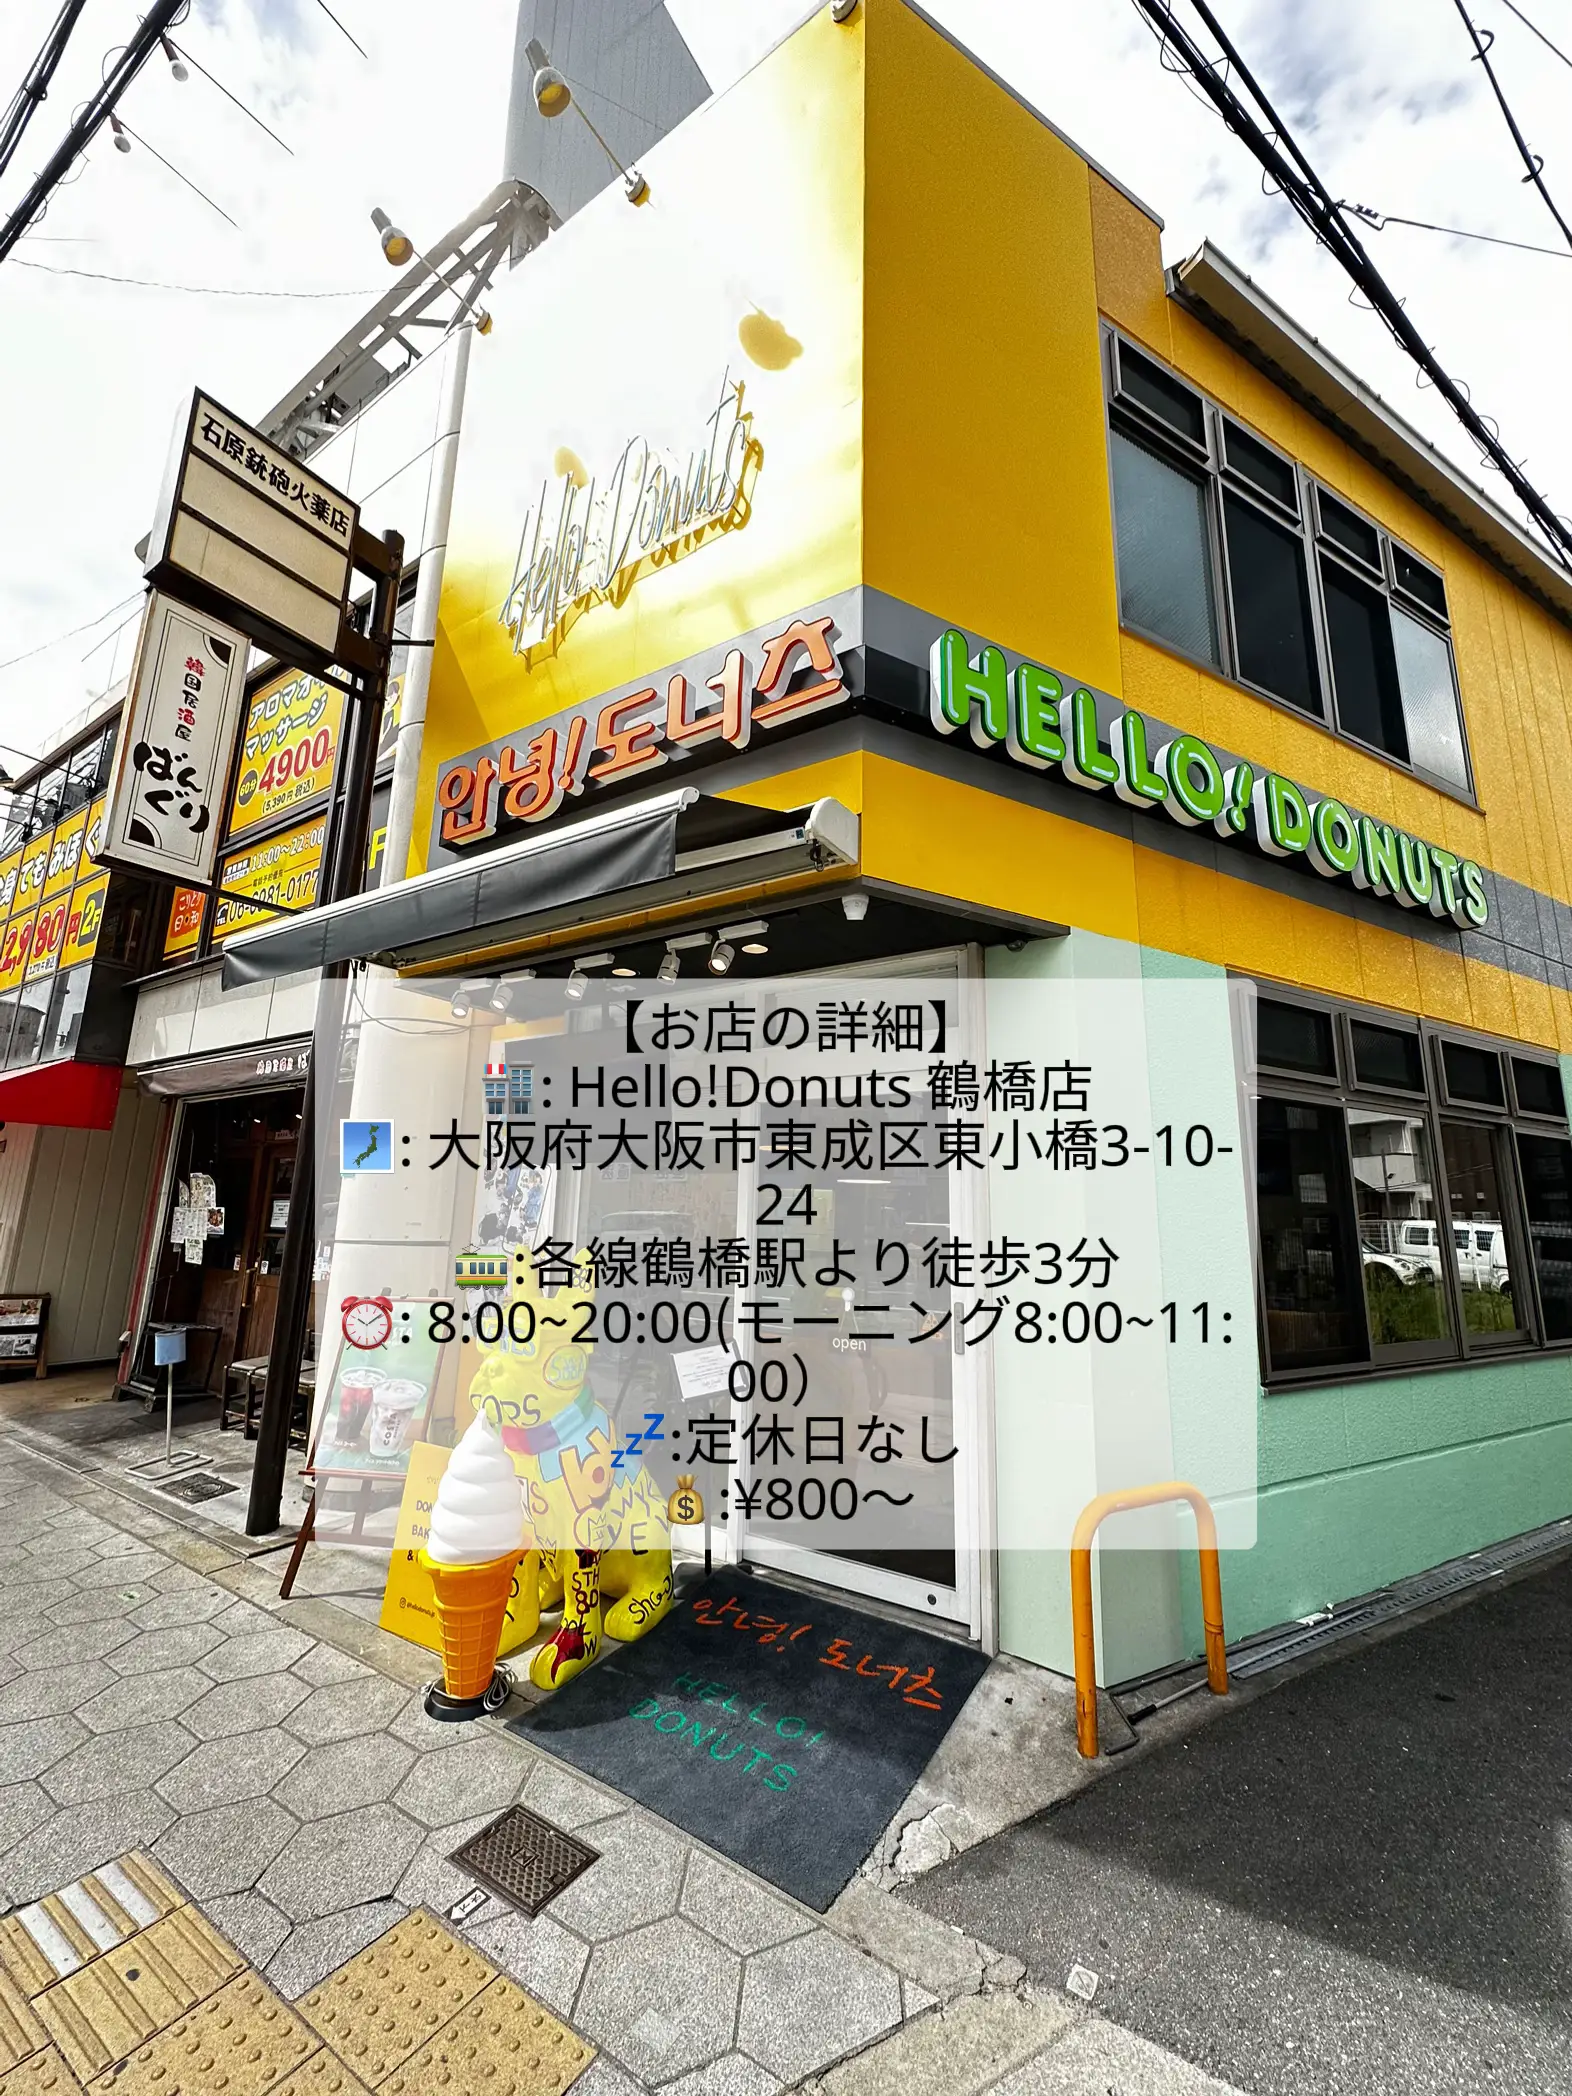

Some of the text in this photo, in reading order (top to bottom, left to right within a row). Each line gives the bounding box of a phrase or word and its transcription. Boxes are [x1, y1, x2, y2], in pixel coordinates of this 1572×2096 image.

[201, 412, 350, 538] 石原銃砲火薬店
[245, 691, 328, 761] マッサージ
[249, 664, 345, 731] アロマオ
[930, 628, 1488, 929] HELLO! DONUTS
[0, 816, 101, 906] 身てもみほぐ
[832, 1337, 867, 1351] open
[412, 1524, 430, 1540] BAK
[416, 1500, 432, 1514] DON
[628, 1698, 798, 1793] DONUTS
[673, 1671, 827, 1748] HELLO!
